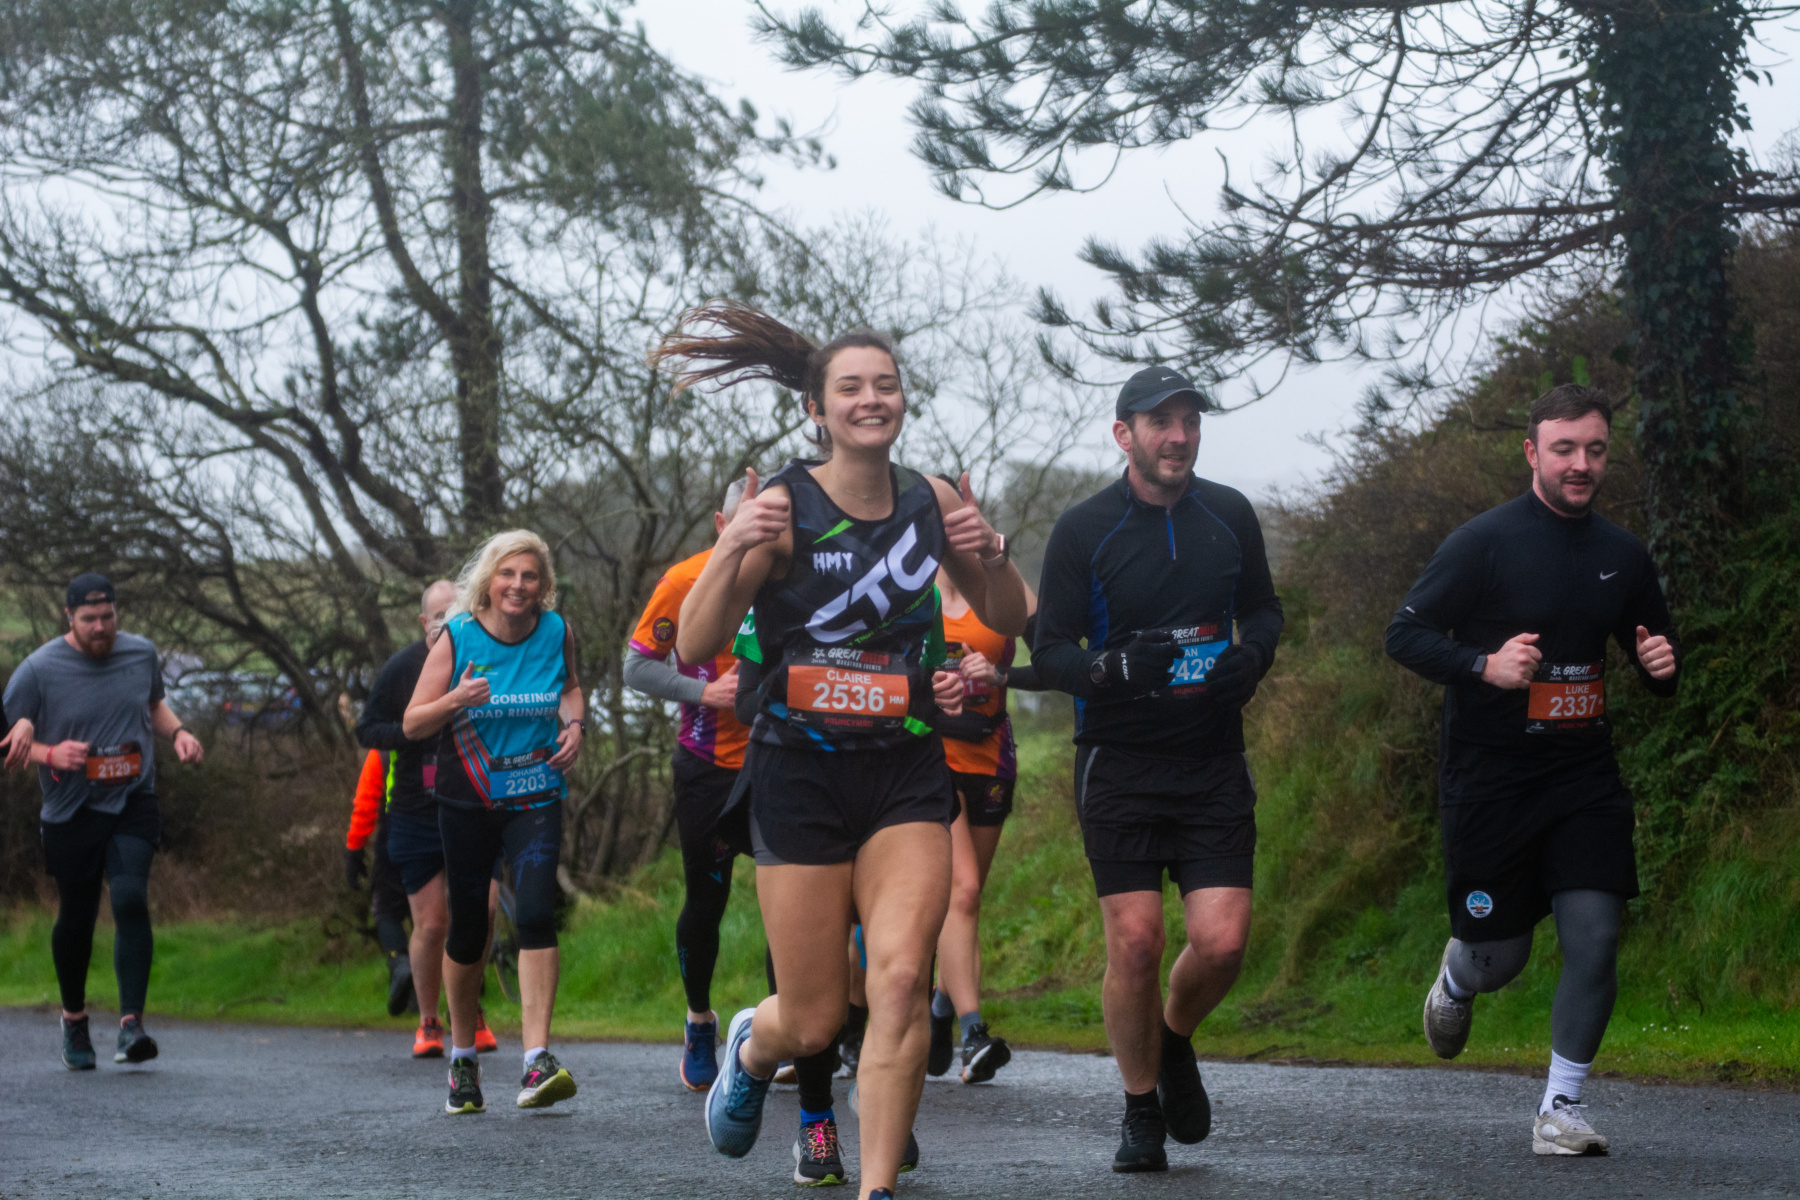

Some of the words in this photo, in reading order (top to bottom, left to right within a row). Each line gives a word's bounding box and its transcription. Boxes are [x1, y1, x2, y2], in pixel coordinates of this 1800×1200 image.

[813, 551, 853, 575] HMY
[827, 647, 863, 661] GREAT
[836, 659, 863, 669] MARATHON
[1563, 665, 1591, 676] GREAT
[826, 670, 872, 685] CLAIRE
[812, 682, 885, 712] 2536
[889, 695, 904, 705] HM
[1565, 685, 1590, 695] LUKE
[490, 691, 558, 705] GORSEINON
[468, 708, 503, 719] ROAD
[508, 706, 558, 718] RUNNERS
[1549, 694, 1598, 717] 2337
[508, 765, 543, 778] JOHANNE
[505, 773, 546, 795] 2203
